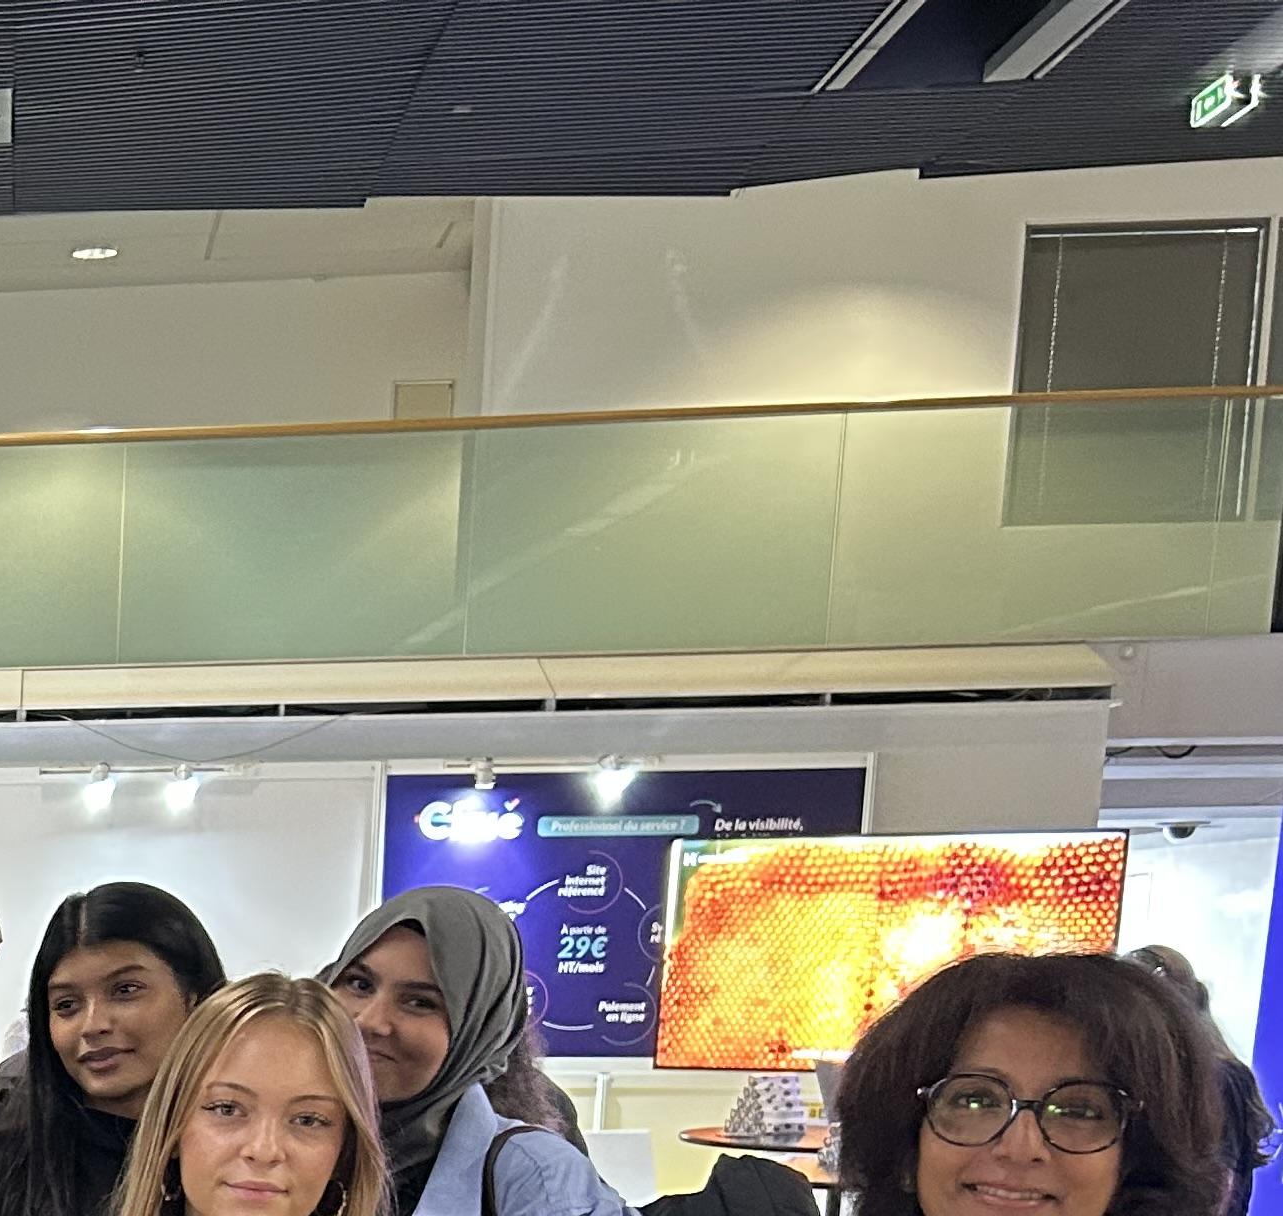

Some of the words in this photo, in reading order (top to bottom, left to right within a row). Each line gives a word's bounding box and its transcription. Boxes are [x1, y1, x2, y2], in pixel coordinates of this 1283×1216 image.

[550, 820, 623, 832] Professionnel
[623, 819, 638, 831] du
[639, 819, 677, 831] service
[714, 818, 732, 832] De
[734, 817, 747, 831] la
[748, 816, 804, 832] visibilité,
[585, 864, 607, 876] Site
[560, 922, 568, 935] À
[569, 924, 593, 937] partir
[594, 924, 607, 935] de
[557, 936, 609, 960] 29€
[557, 961, 605, 975] HT/mois
[597, 1000, 647, 1013] Paiement
[605, 1012, 619, 1023] en
[619, 1010, 646, 1025] ligne
